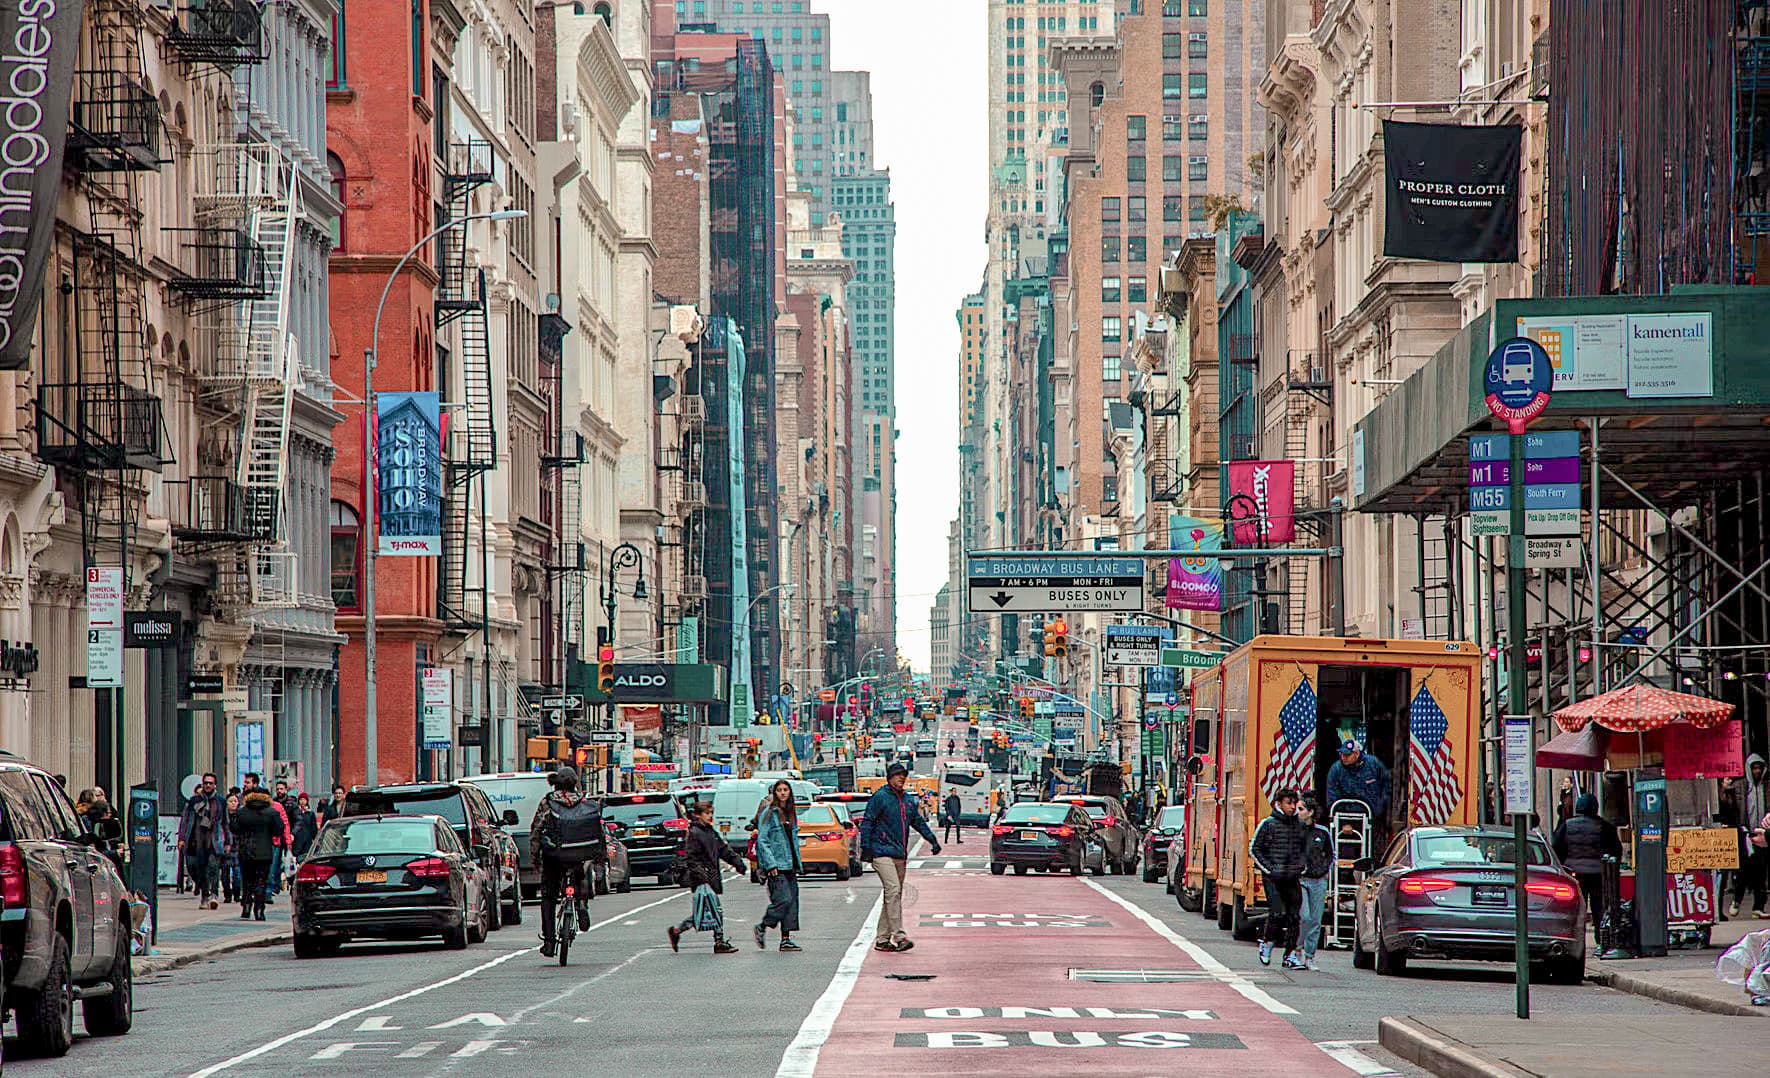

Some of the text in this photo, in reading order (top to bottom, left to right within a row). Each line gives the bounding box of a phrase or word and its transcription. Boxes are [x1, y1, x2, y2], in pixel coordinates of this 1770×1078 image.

[1399, 179, 1506, 195] PROPER CLOTH
[1432, 199, 1458, 207] CUSTOM
[1459, 200, 1493, 208] CLOTHING
[1633, 323, 1705, 339] kamentall
[1490, 397, 1545, 419] NO STANDING
[1472, 439, 1491, 457] M1
[418, 428, 431, 507] BROADWAY
[1472, 464, 1492, 482] M1
[1473, 489, 1504, 507] M55
[1527, 488, 1566, 498] South Ferry
[1473, 524, 1509, 534] Sightseeing
[1527, 541, 1562, 551] Broadway
[1527, 549, 1562, 559] Spring St
[993, 563, 1119, 574] BROADWAY BUS LANE
[91, 570, 97, 581] 3
[1049, 590, 1127, 601] BUSES ONLY
[134, 620, 172, 635] melissa
[91, 631, 97, 642] 2
[614, 675, 667, 687] ALDO
[1667, 886, 1709, 918] UTS
[923, 1007, 1215, 1020] ONLY
[927, 1031, 1192, 1049] BUS
